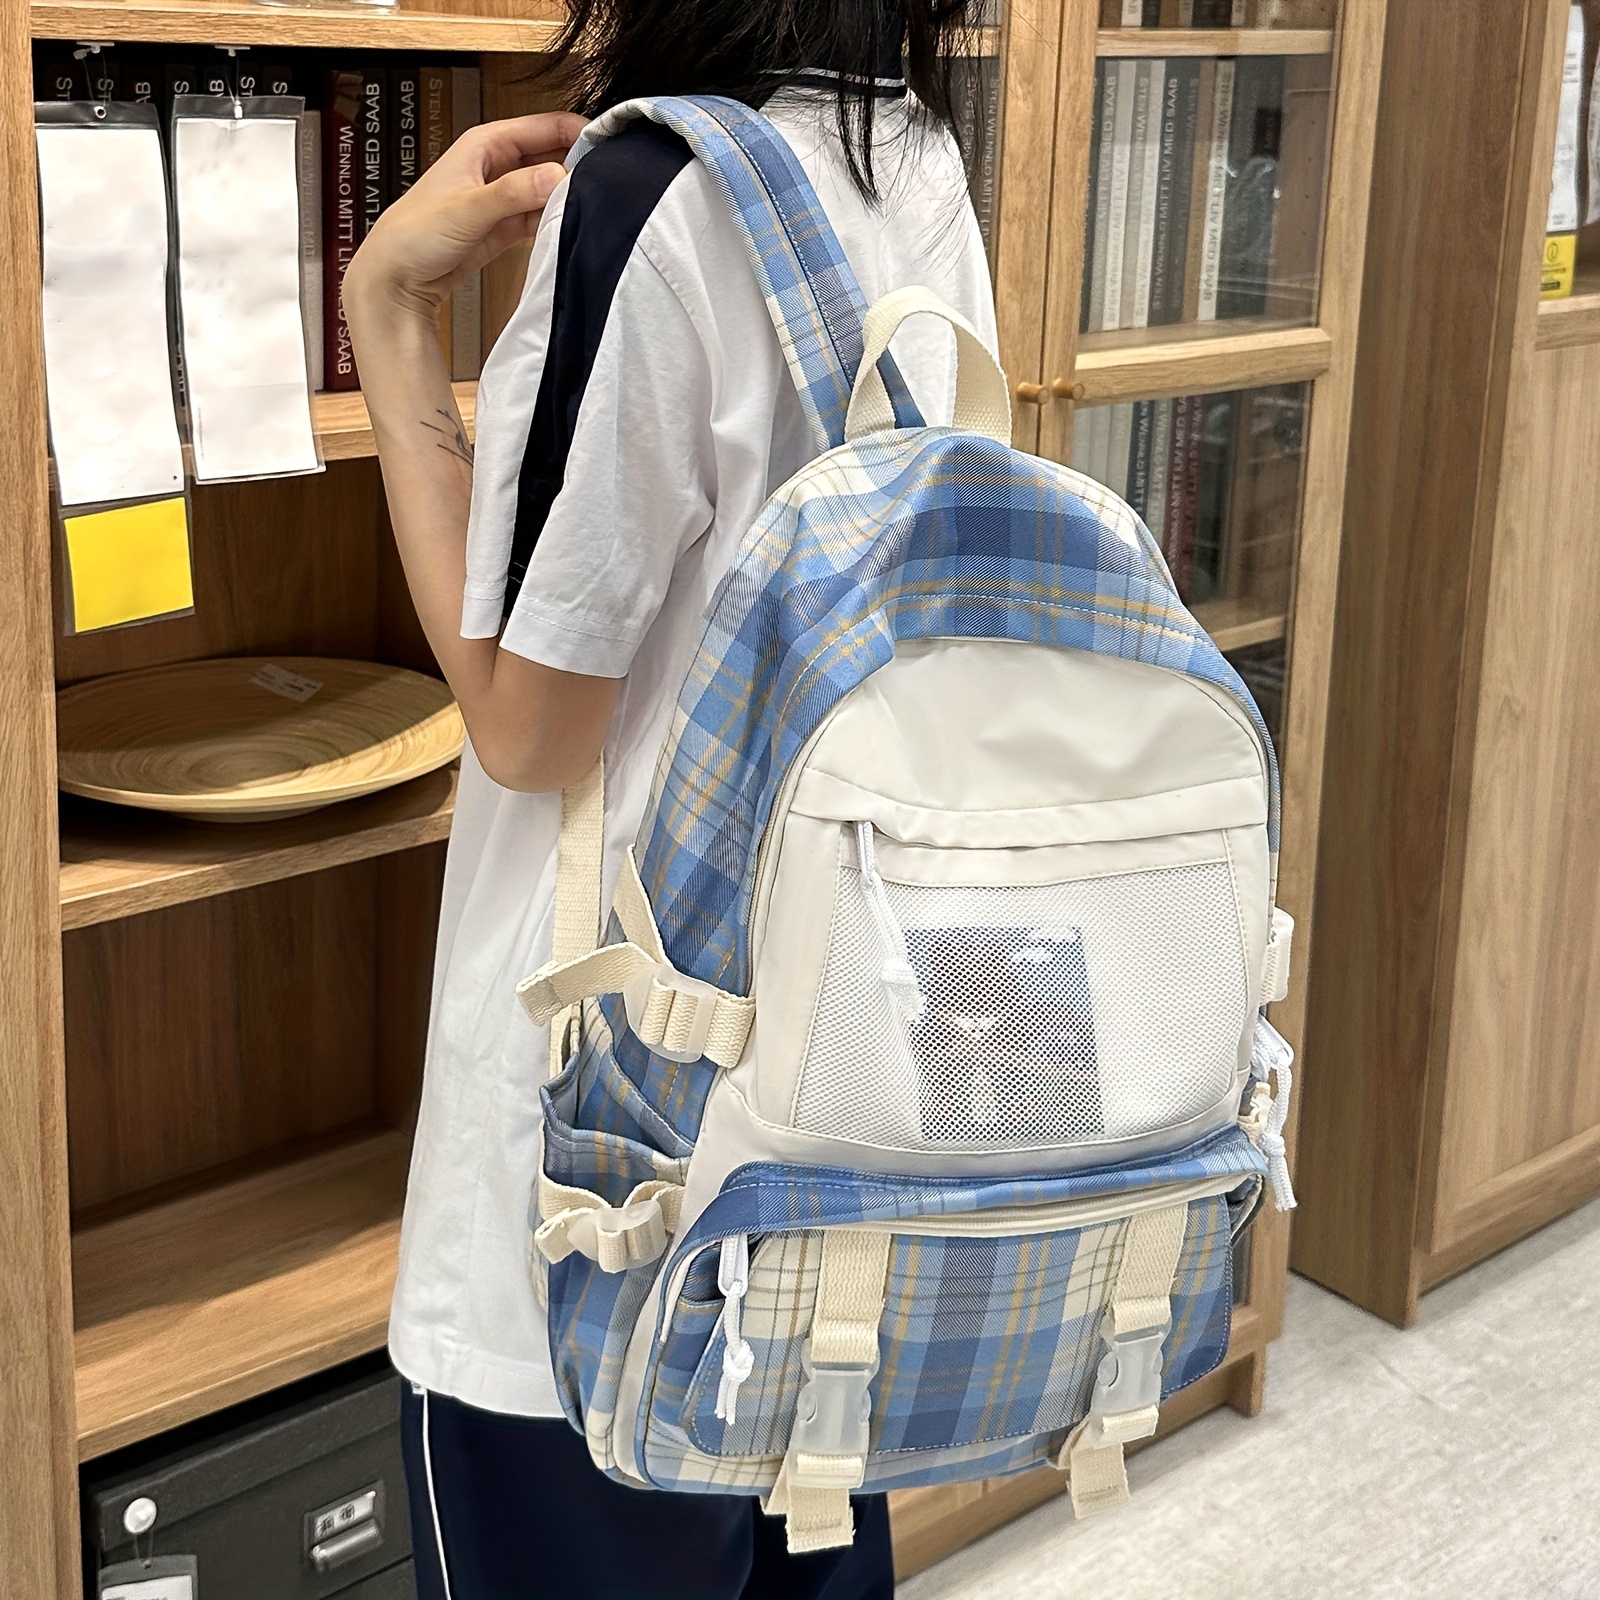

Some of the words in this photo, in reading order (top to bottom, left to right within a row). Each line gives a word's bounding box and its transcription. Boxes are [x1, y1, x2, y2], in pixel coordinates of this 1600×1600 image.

[56, 77, 72, 101] ST
[97, 79, 114, 101] ST
[365, 83, 380, 134] SAAB
[401, 80, 415, 130] SAAB
[429, 78, 443, 120] STEN
[1103, 76, 1116, 117] SAAB
[1136, 77, 1149, 112] STEN
[1166, 78, 1178, 117] SAAB
[401, 135, 415, 176] MED
[428, 123, 443, 164] WEN
[1164, 122, 1175, 154] MED
[338, 125, 355, 196] WENNLO
[365, 139, 380, 180] MED
[1161, 159, 1172, 181] LIV
[365, 186, 380, 213] LIV
[1159, 184, 1170, 219] MITT
[338, 199, 353, 243] MITT
[1152, 276, 1164, 310] STEN
[337, 326, 352, 375] SAAB
[1177, 396, 1190, 414] SA
[1175, 416, 1187, 448] MED
